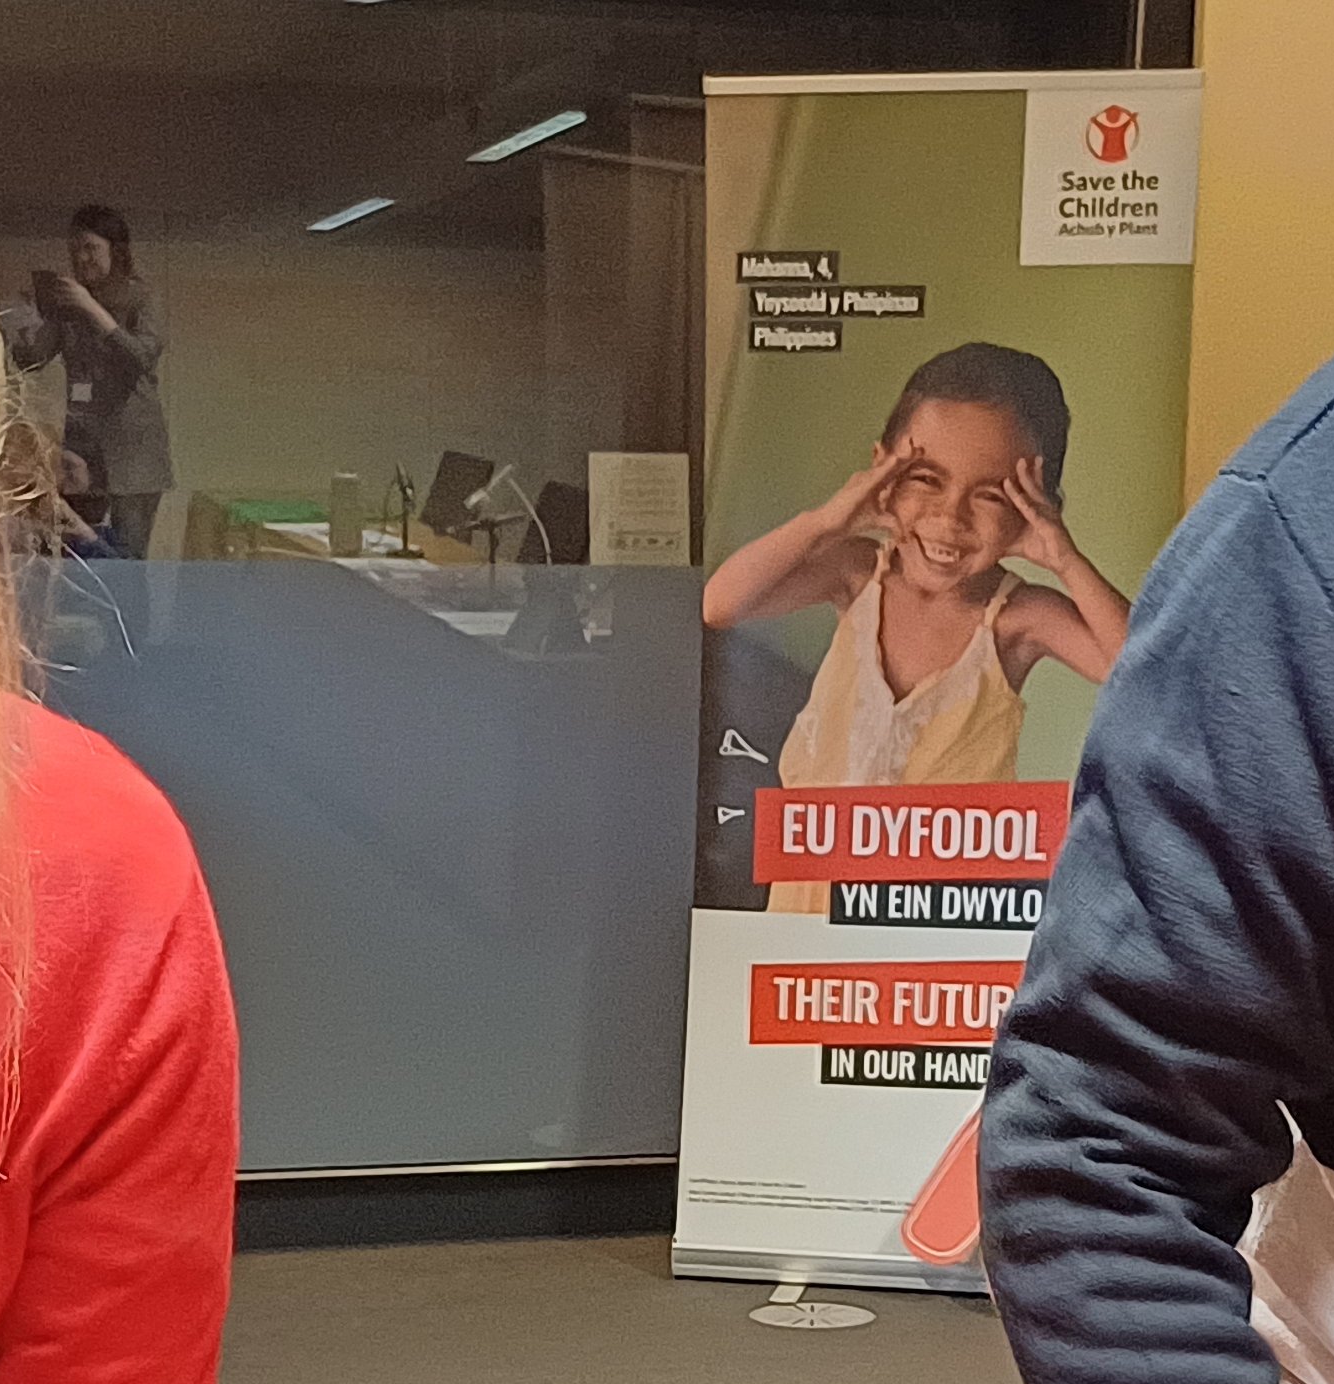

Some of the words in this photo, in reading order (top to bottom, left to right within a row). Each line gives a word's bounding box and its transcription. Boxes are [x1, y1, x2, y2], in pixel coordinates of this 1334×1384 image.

[1060, 170, 1116, 192] Save
[1121, 169, 1160, 191] the
[1058, 196, 1159, 219] Children
[1119, 221, 1159, 236] Plant
[829, 296, 840, 316] y
[782, 803, 836, 855] EU
[851, 804, 1047, 862] DYFODOL
[840, 883, 878, 918] YN
[887, 884, 932, 920] EIN
[941, 886, 1043, 923] DWYLO
[773, 976, 879, 1025] THEIR
[830, 1047, 855, 1079] IN
[863, 1049, 916, 1081] OUR
[924, 1051, 992, 1084] HAND
